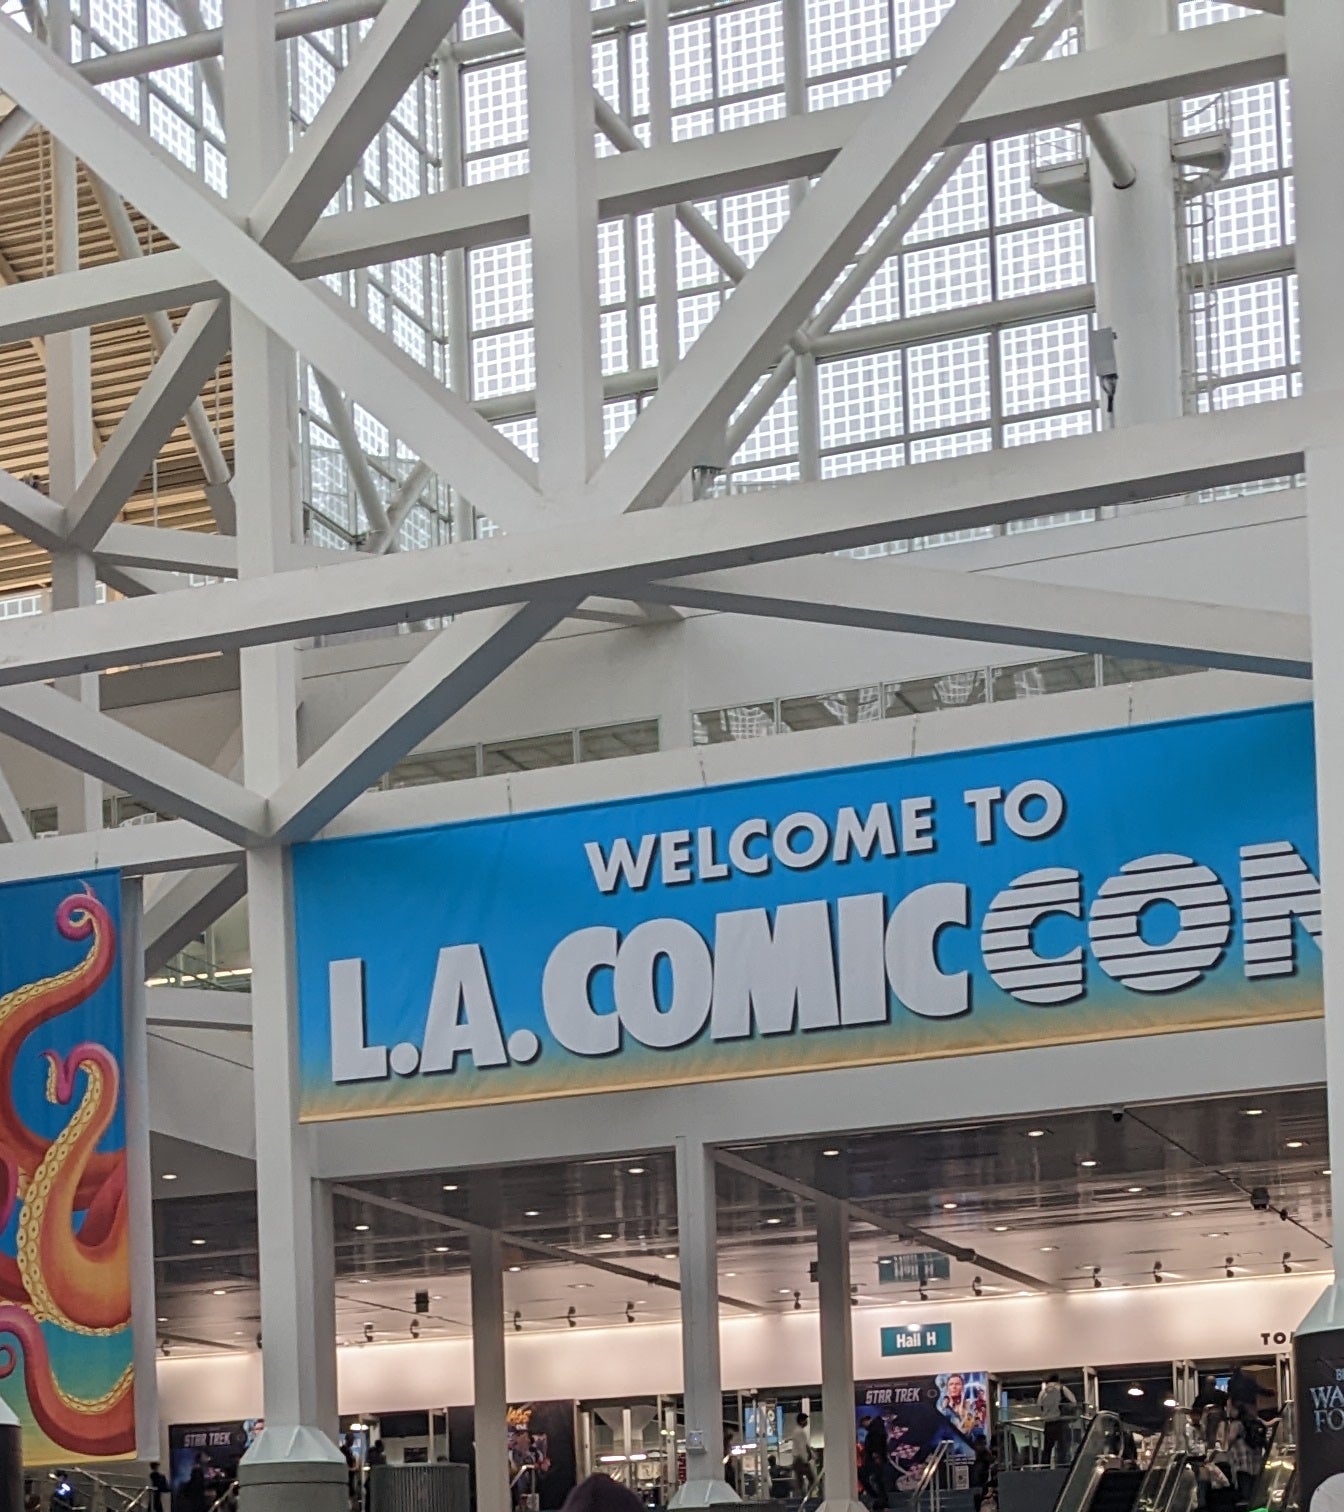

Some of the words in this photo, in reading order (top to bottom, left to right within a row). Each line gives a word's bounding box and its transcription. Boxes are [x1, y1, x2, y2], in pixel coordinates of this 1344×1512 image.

[584, 796, 936, 892] WELCOME
[963, 779, 1065, 843] TO
[896, 1332, 921, 1349] Hall
[926, 1331, 937, 1347] H
[865, 1389, 891, 1405] STAR
[894, 1387, 921, 1403] TREK
[184, 1433, 207, 1448] STAR
[209, 1431, 231, 1447] TREK
